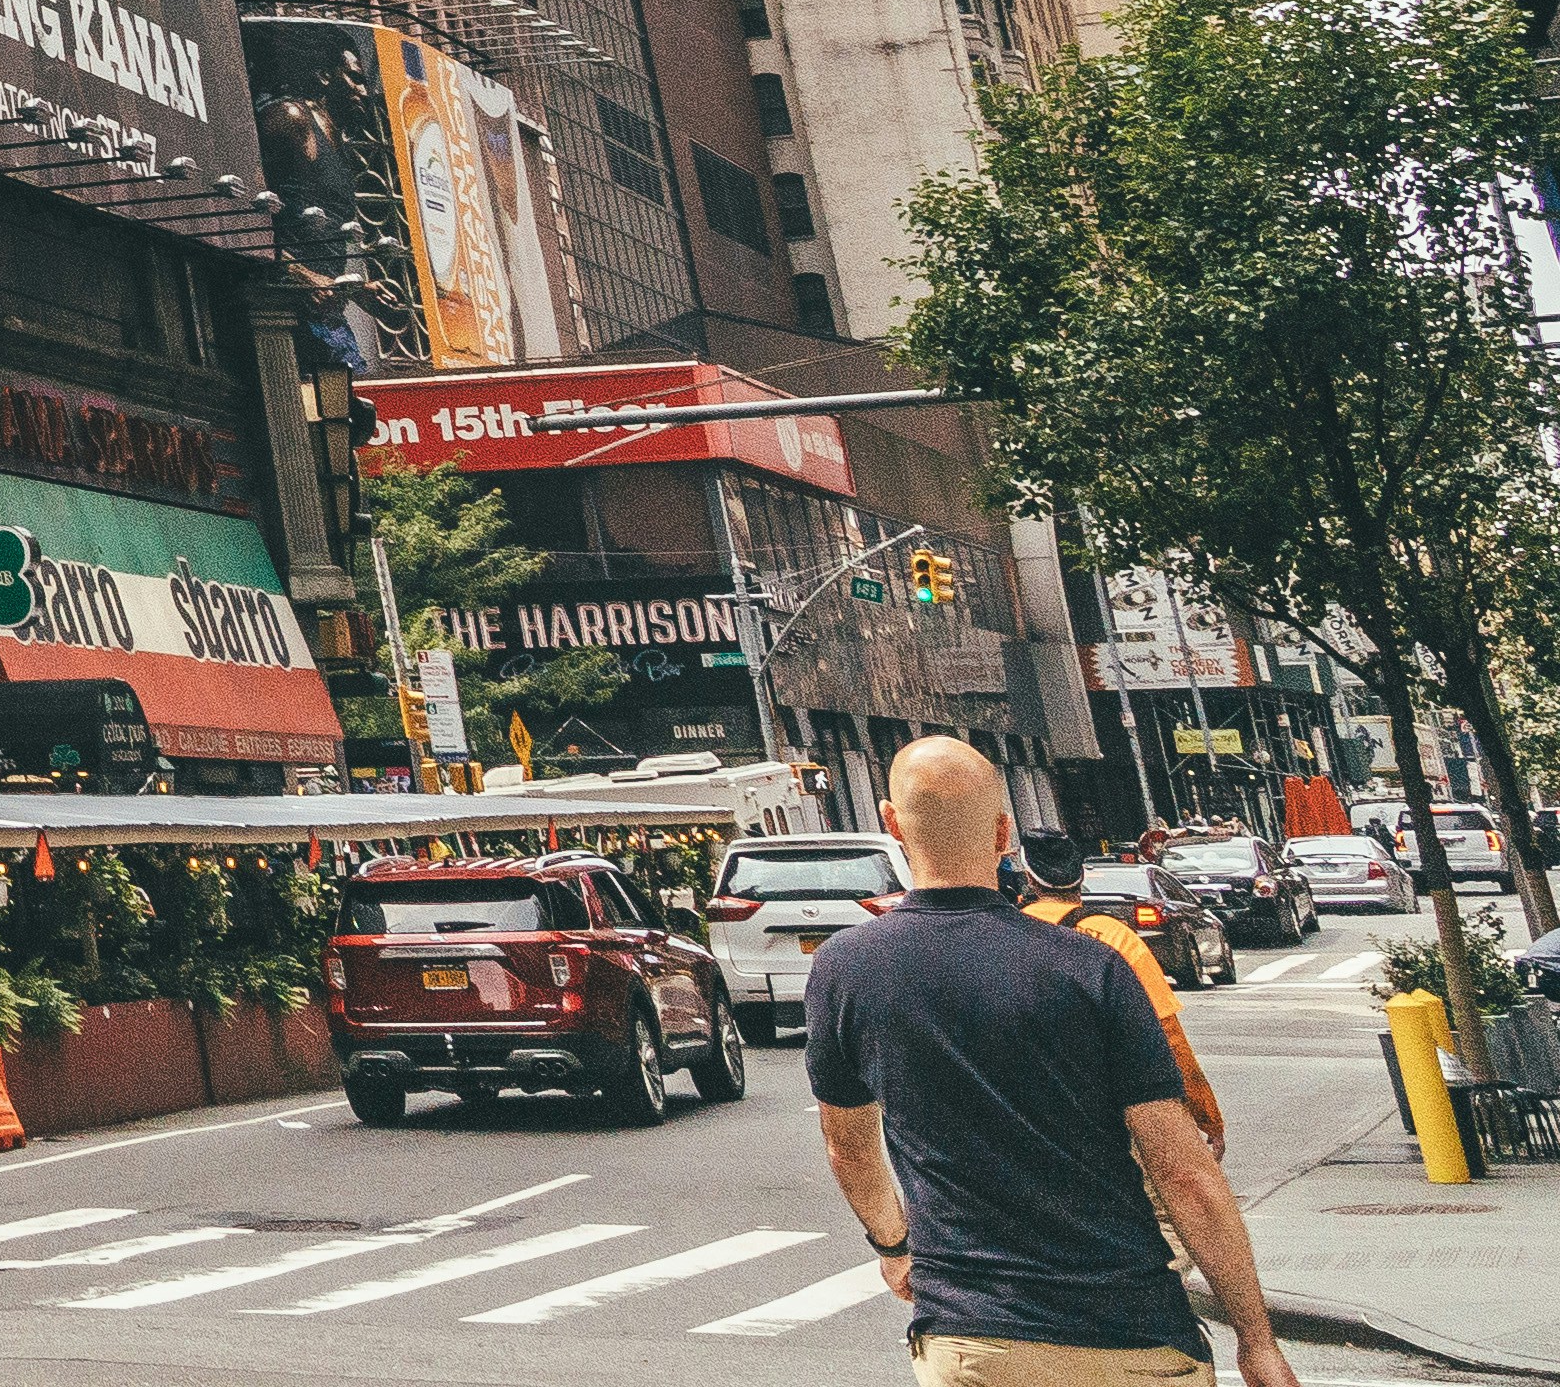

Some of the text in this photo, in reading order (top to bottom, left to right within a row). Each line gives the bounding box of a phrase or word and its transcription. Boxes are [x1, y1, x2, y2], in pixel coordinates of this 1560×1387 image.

[369, 404, 530, 449] on 15th
[170, 556, 291, 669] sbarro
[430, 598, 738, 650] THE HARRISON
[673, 724, 725, 740] DINNER
